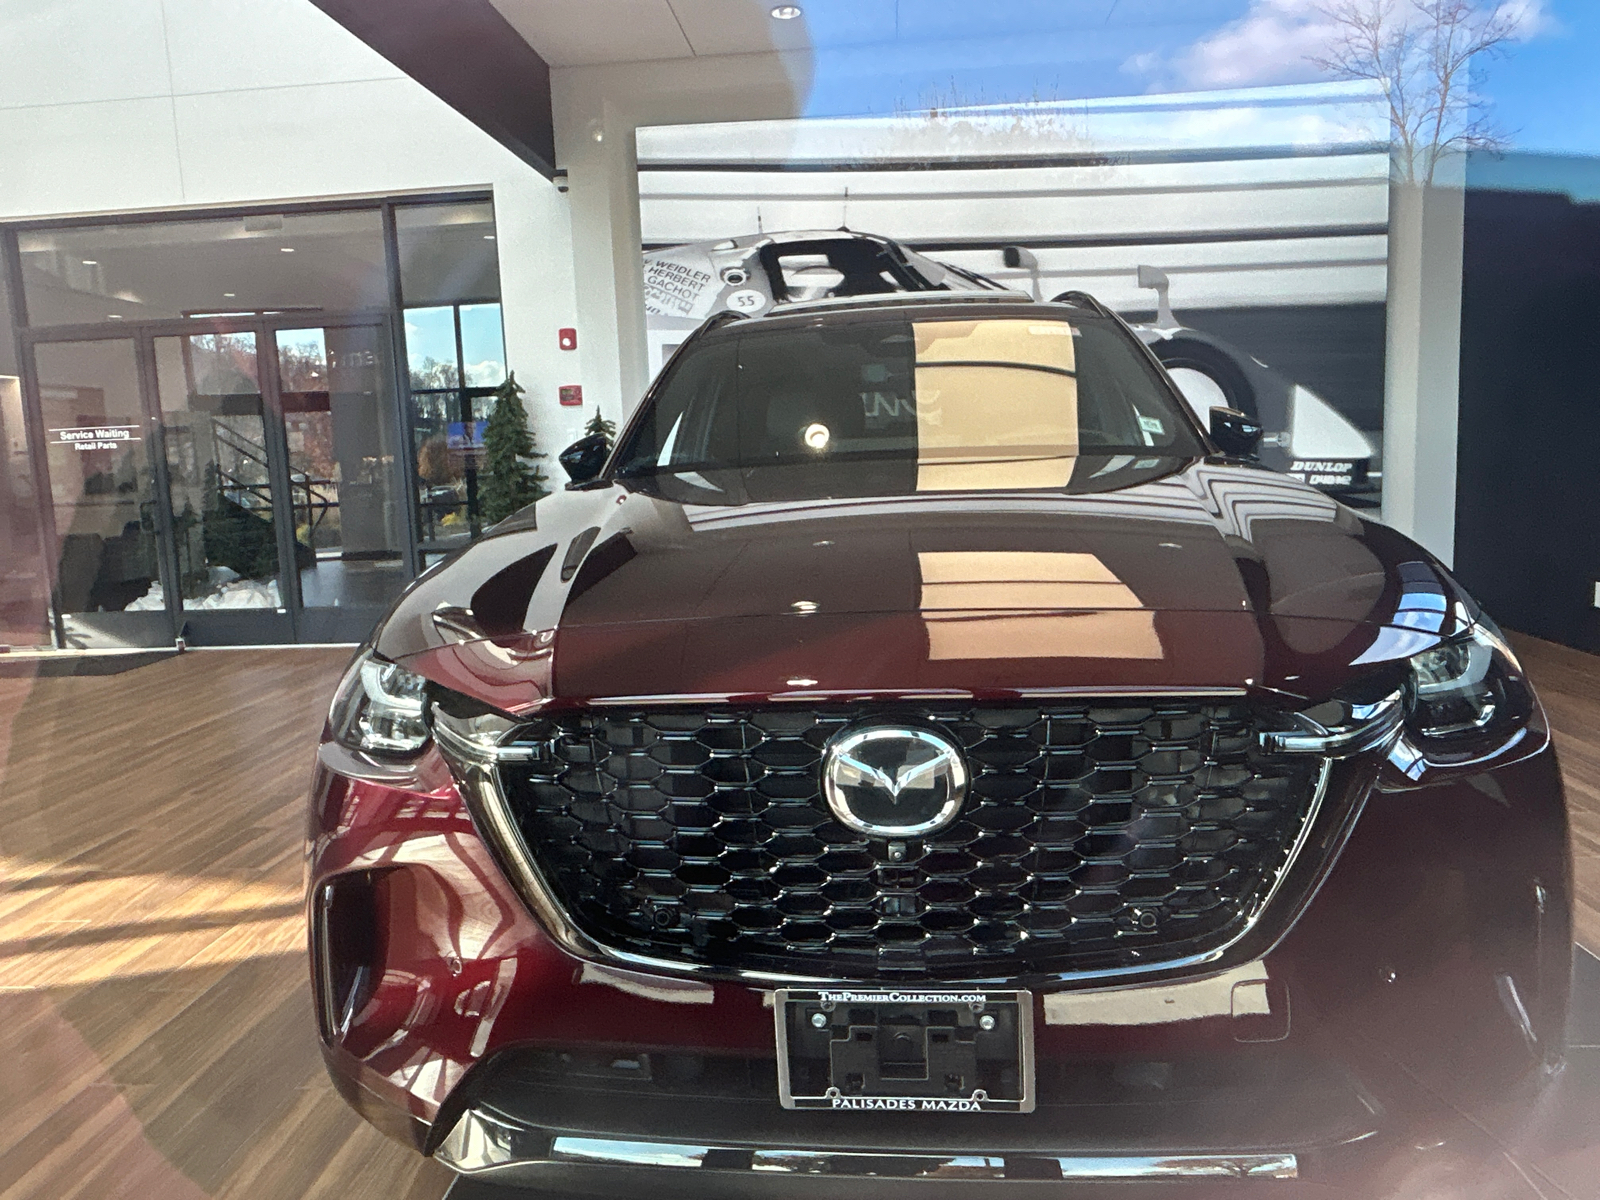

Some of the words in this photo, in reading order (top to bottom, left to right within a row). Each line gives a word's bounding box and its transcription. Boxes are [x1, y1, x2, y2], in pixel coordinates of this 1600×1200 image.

[656, 260, 711, 283] WEIDLER
[648, 266, 706, 292] HERBERT
[647, 275, 700, 301] GACHOT
[737, 295, 755, 307] 55
[60, 431, 94, 440] Service
[95, 429, 130, 440] Waiting
[74, 443, 97, 451] Retail
[98, 442, 117, 450] Parts
[1290, 461, 1353, 473] DUNLOP
[832, 1099, 916, 1110] PALISADES
[921, 1100, 982, 1111] MAZDA
